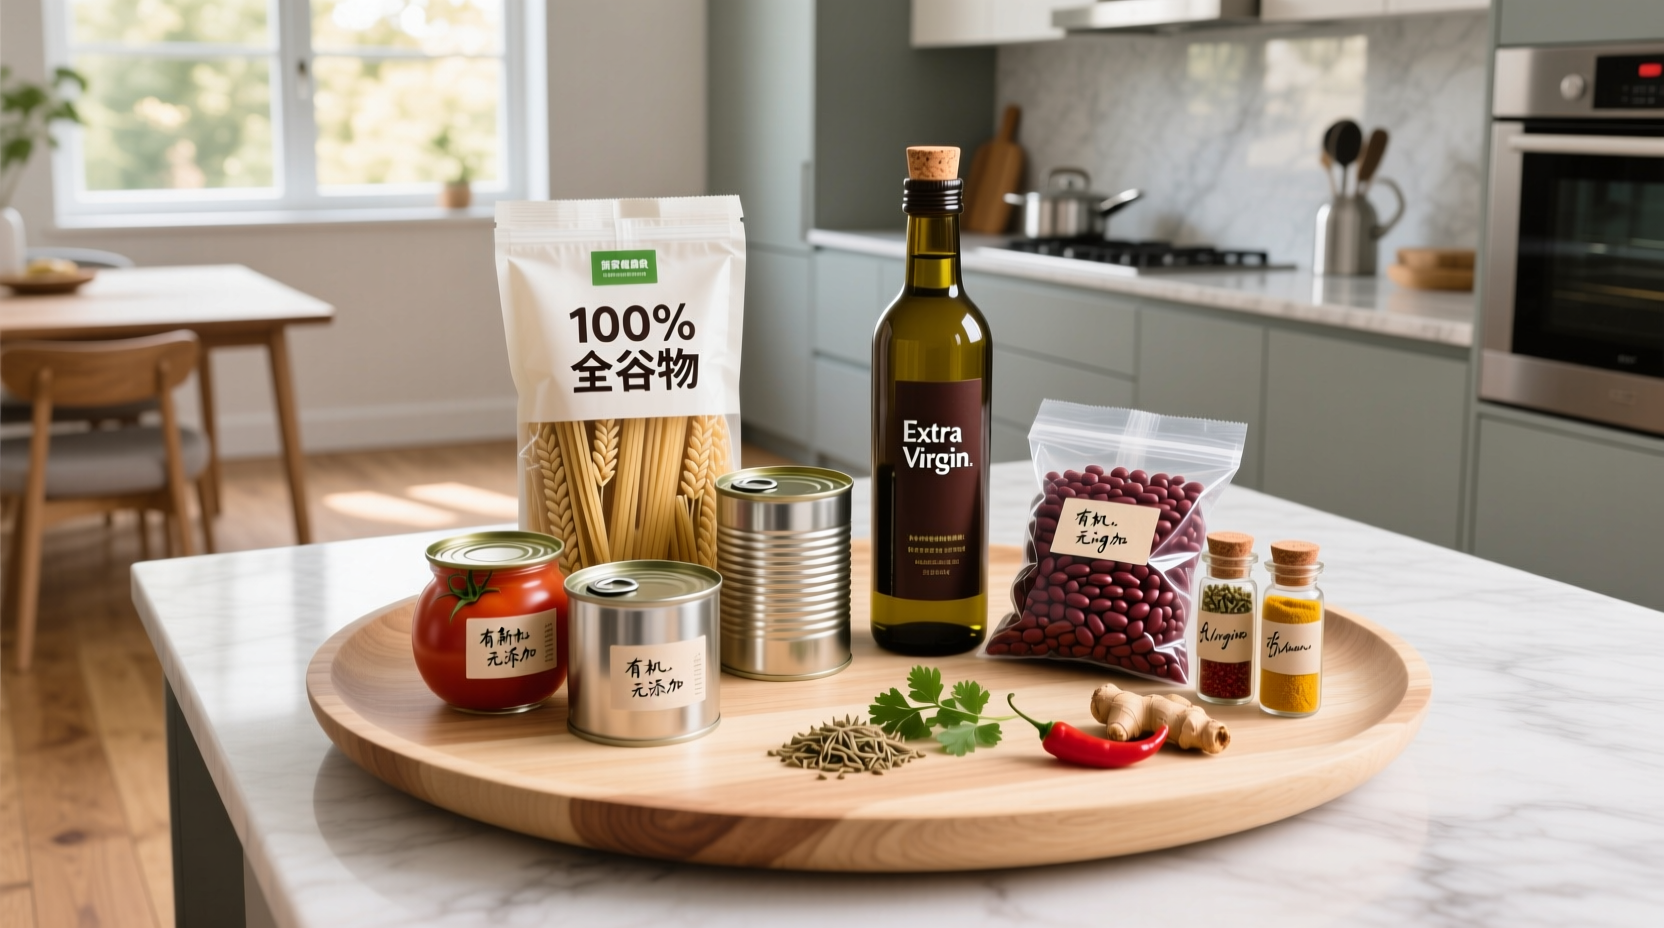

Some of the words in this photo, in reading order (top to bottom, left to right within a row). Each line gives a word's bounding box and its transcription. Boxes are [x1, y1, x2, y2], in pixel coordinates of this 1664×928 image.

[569, 302, 696, 344] 100%
[570, 347, 699, 394] 全谷物
[903, 419, 962, 443] Extra
[902, 446, 973, 476] Virgin.
